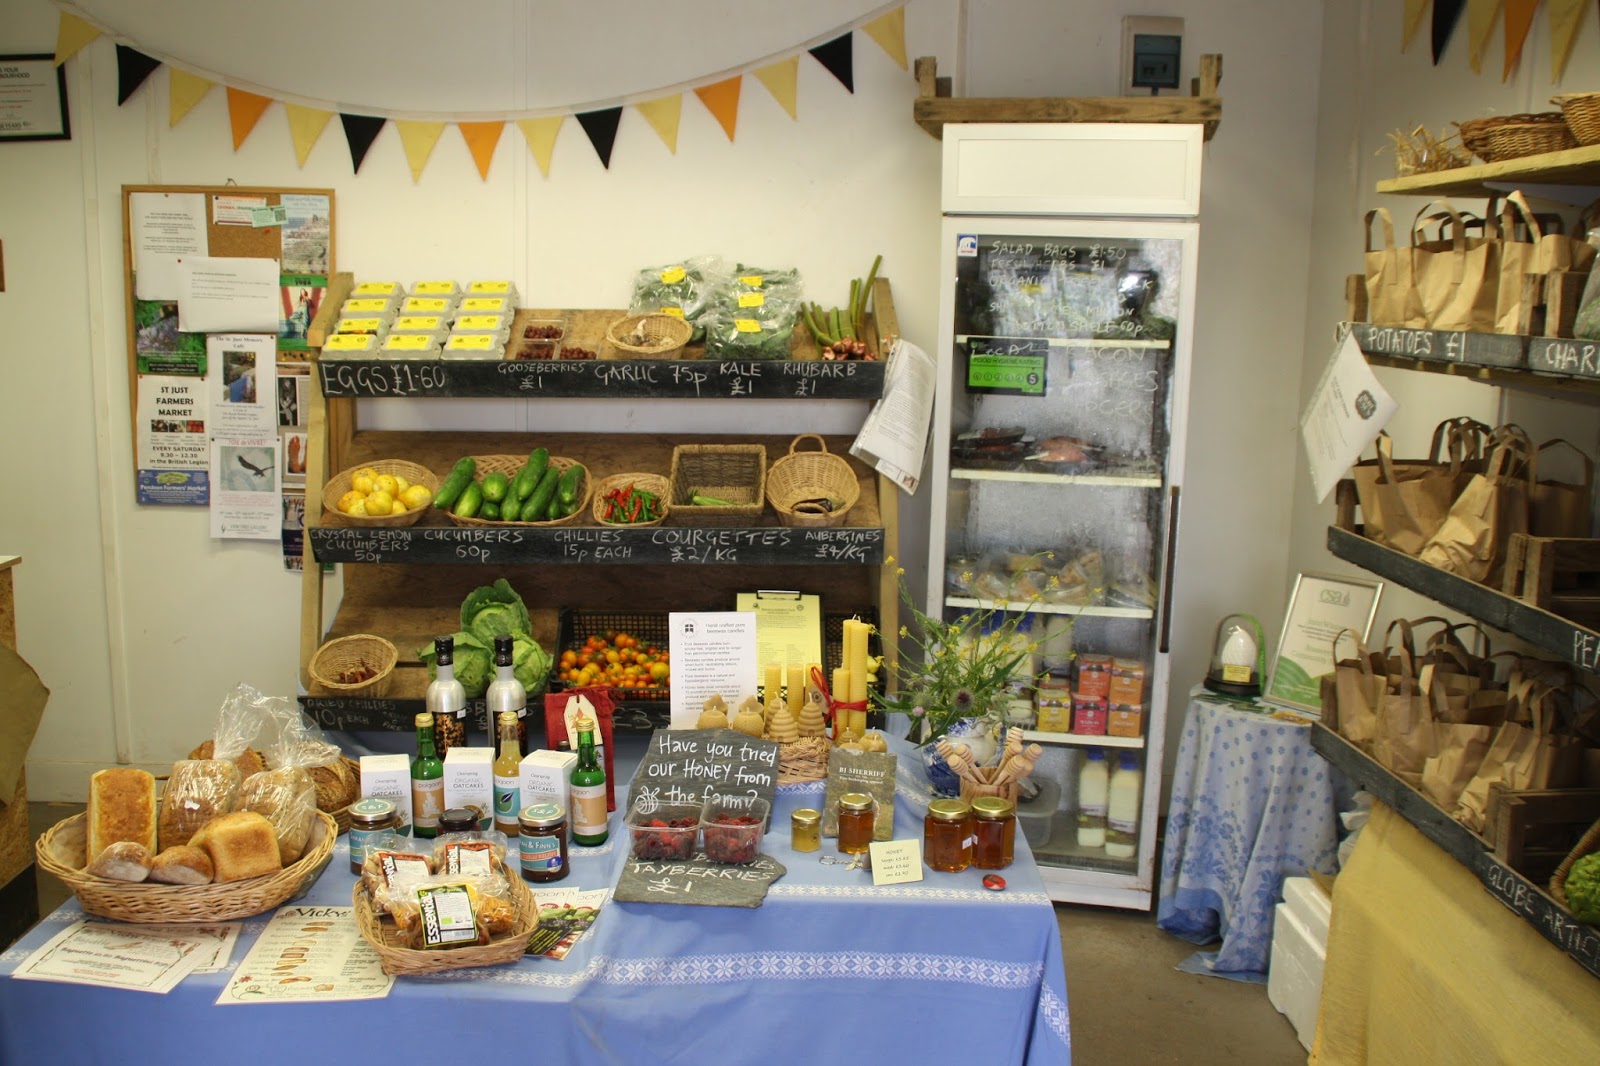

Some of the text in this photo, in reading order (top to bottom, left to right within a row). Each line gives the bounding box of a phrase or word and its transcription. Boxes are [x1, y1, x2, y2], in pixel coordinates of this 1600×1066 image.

[990, 240, 1034, 255] SALAD
[1044, 242, 1076, 258] BAGS
[1368, 326, 1466, 362] POTATOES £1
[1545, 343, 1600, 374] CHAR
[498, 362, 585, 374] GOOSEBERRIES
[719, 362, 762, 378] KALE
[783, 362, 857, 378] RHUBARB
[322, 364, 388, 394] EGGS
[519, 375, 542, 389] £1
[594, 364, 708, 396] GARLIC 75p
[730, 377, 753, 395] £1
[795, 378, 816, 396] £1
[310, 529, 412, 541] CRYSTAL LEMON
[424, 530, 523, 543] CUCUMBERS
[554, 530, 623, 542] CHILLIES
[651, 529, 792, 546] COURGETTES
[805, 530, 880, 542] AUBERGINES
[326, 539, 410, 551] CUCUMBERS
[564, 543, 632, 562] 15p EACH
[354, 551, 382, 563] 50p
[456, 546, 490, 563] 60p
[307, 698, 344, 709] DRIED
[314, 708, 344, 730] 10p
[659, 734, 778, 767] Have you tried
[648, 759, 770, 786] our HONEY from
[848, 768, 885, 777] SHERRIFF
[665, 785, 696, 806] the
[628, 861, 775, 881] TAYBERRIES
[647, 877, 693, 894] £1
[1488, 864, 1538, 915] GLOBE
